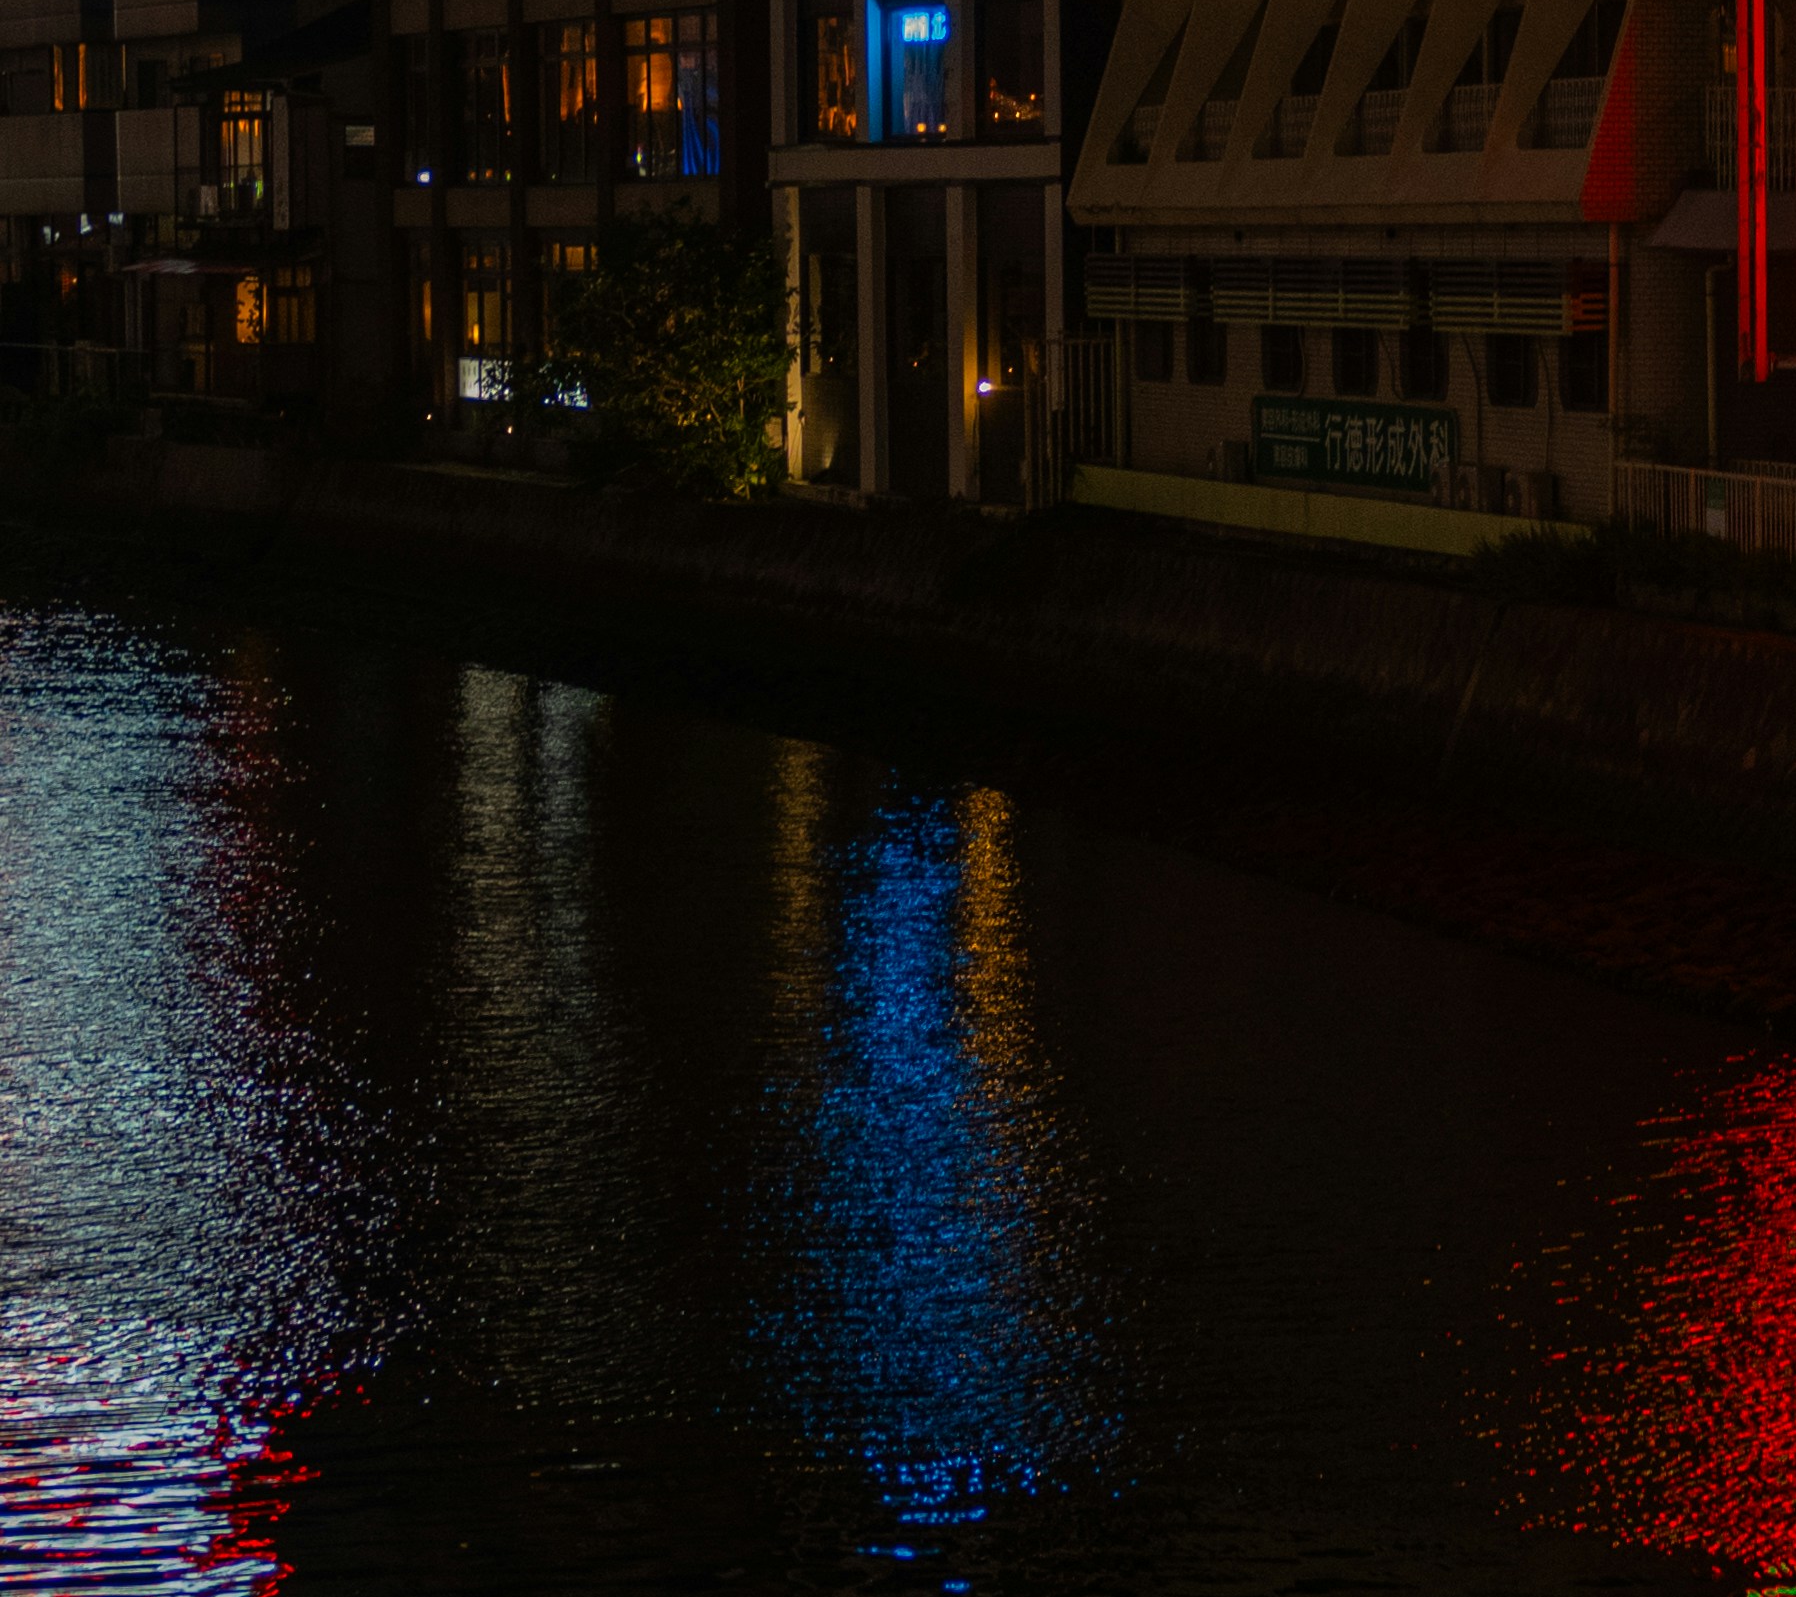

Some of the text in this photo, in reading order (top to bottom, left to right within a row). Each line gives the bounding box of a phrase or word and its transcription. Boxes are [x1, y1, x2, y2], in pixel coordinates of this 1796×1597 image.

[1324, 412, 1450, 479] 行徳形成外科
